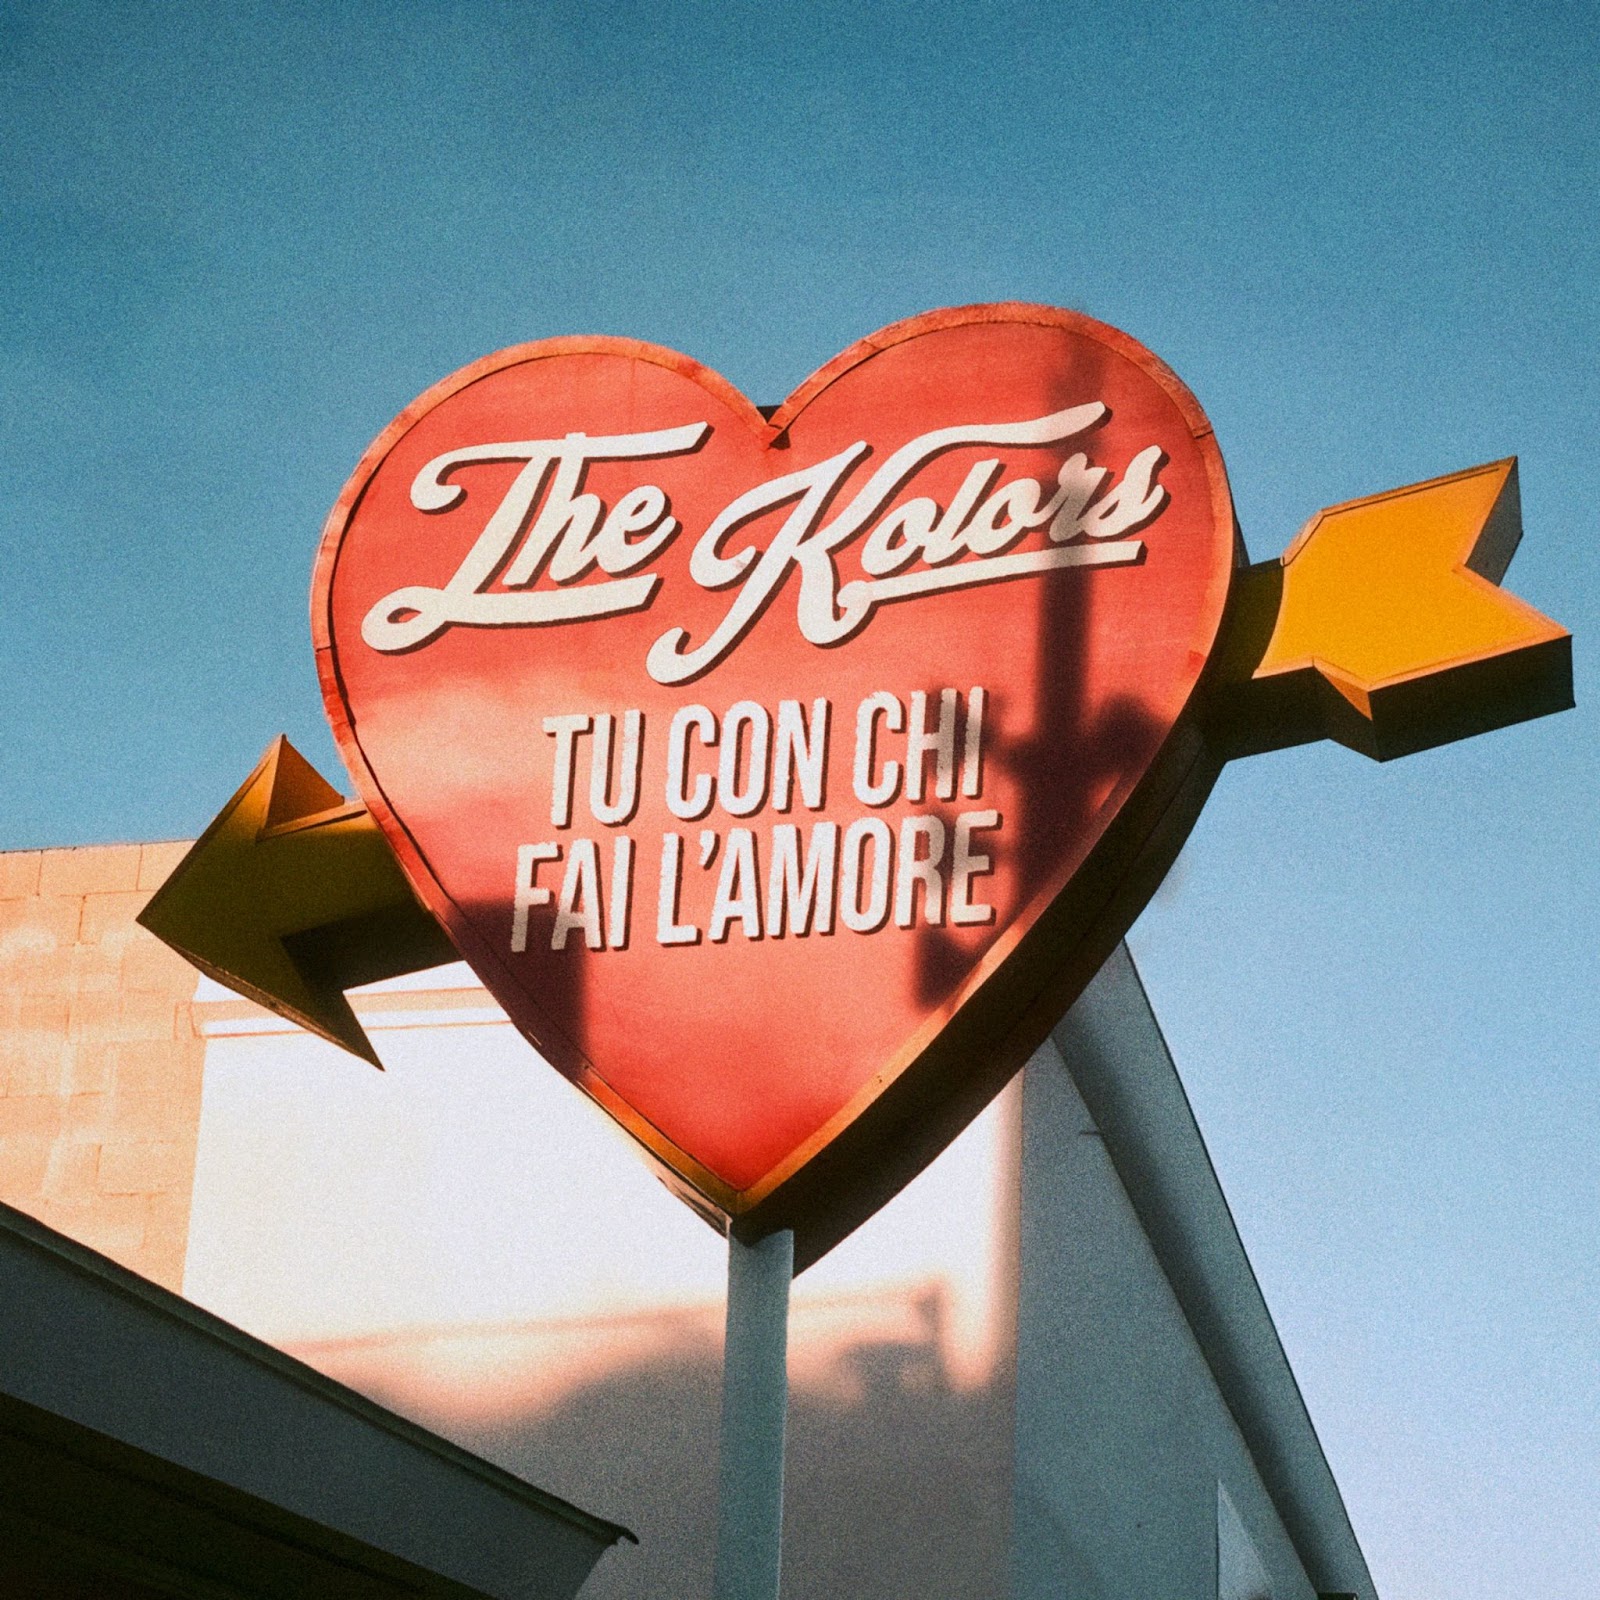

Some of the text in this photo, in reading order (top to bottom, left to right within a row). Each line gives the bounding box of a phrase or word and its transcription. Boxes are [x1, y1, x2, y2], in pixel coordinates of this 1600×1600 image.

[362, 401, 1166, 684] The Kolors
[542, 687, 988, 828] TU CON CHI
[510, 809, 1004, 952] FAI L'AMORE
